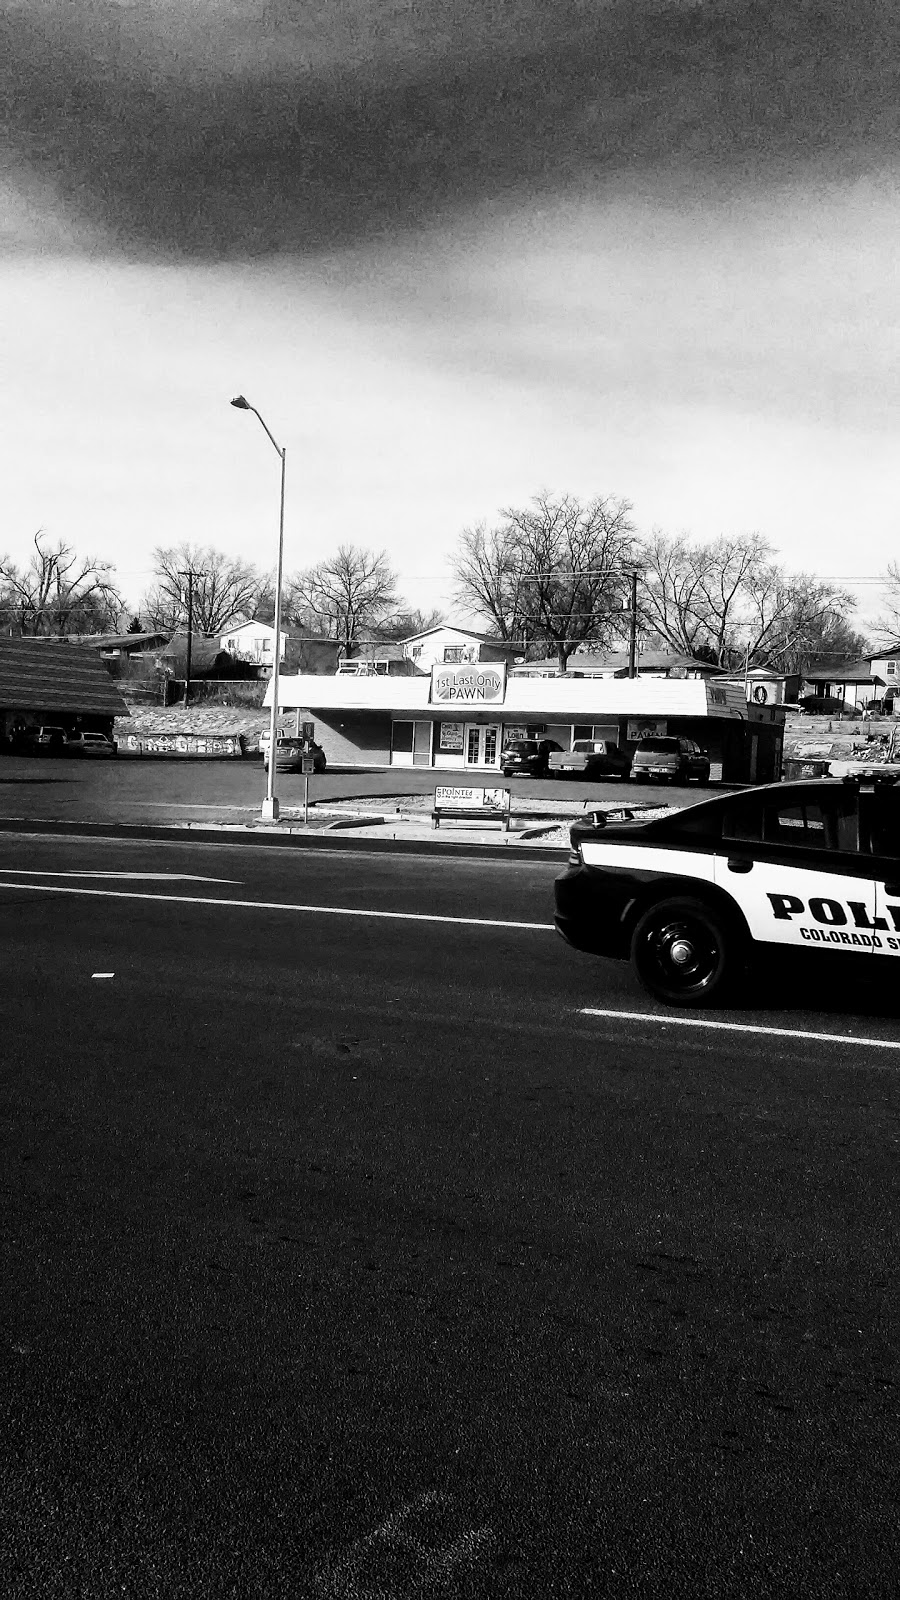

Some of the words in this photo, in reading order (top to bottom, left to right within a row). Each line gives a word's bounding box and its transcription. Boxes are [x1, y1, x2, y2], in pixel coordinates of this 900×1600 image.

[437, 677, 450, 689] 1st
[453, 675, 474, 686] Last
[476, 674, 501, 690] Only
[449, 687, 485, 700] PAWN
[799, 927, 883, 948] COLORADO
[886, 937, 900, 950] S
